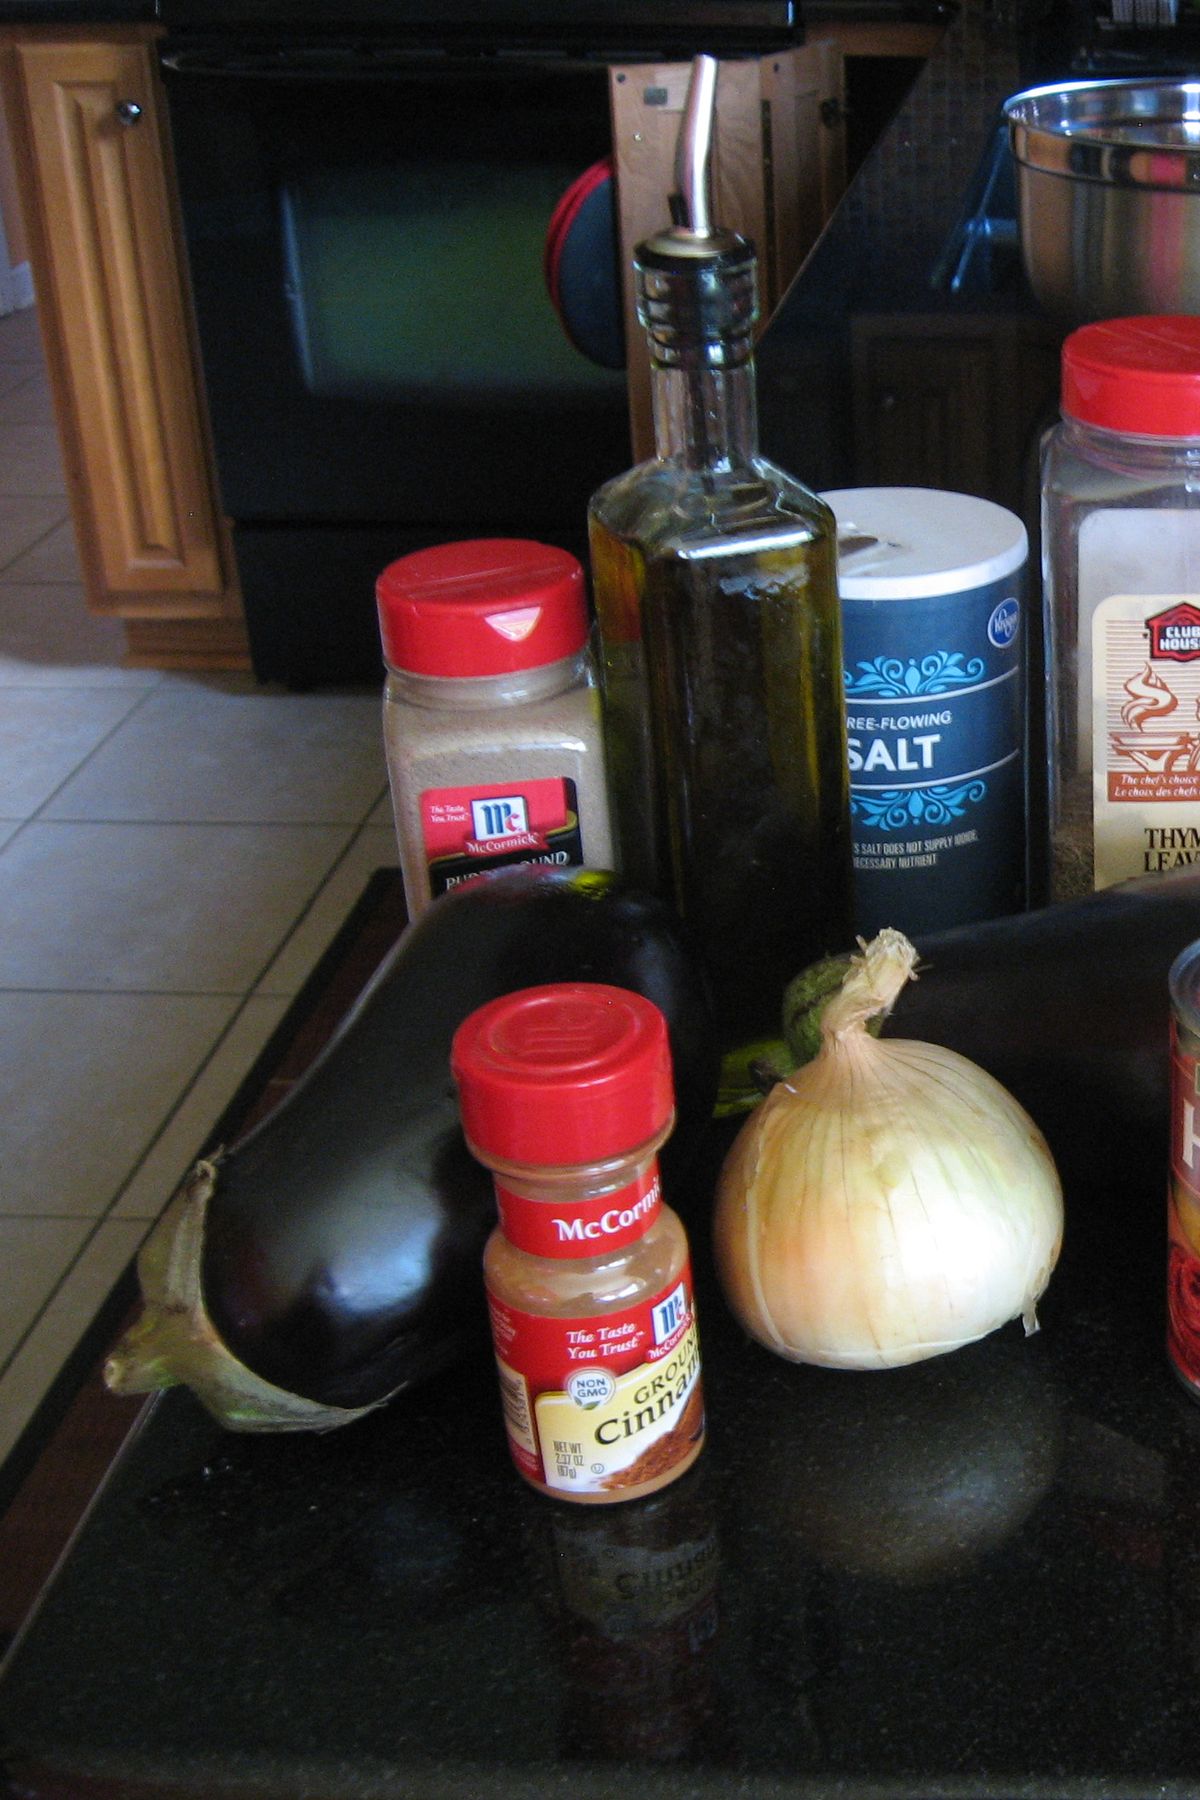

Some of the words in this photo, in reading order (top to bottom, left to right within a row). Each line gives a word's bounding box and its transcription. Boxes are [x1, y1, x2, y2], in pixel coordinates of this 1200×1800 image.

[847, 710, 952, 731] REE-FLOWING
[847, 734, 941, 772] SALT
[1121, 774, 1137, 785] The
[1169, 774, 1198, 785] choice
[1115, 786, 1128, 797] Le
[1156, 786, 1172, 797] des
[466, 833, 538, 854] McCormick
[853, 856, 897, 869] ECESSARY
[551, 1176, 660, 1242] McCormi
[566, 1331, 594, 1344] The
[598, 1322, 637, 1341] Taste
[567, 1346, 597, 1361] You
[576, 1378, 606, 1390] NON
[577, 1387, 608, 1399] GMO
